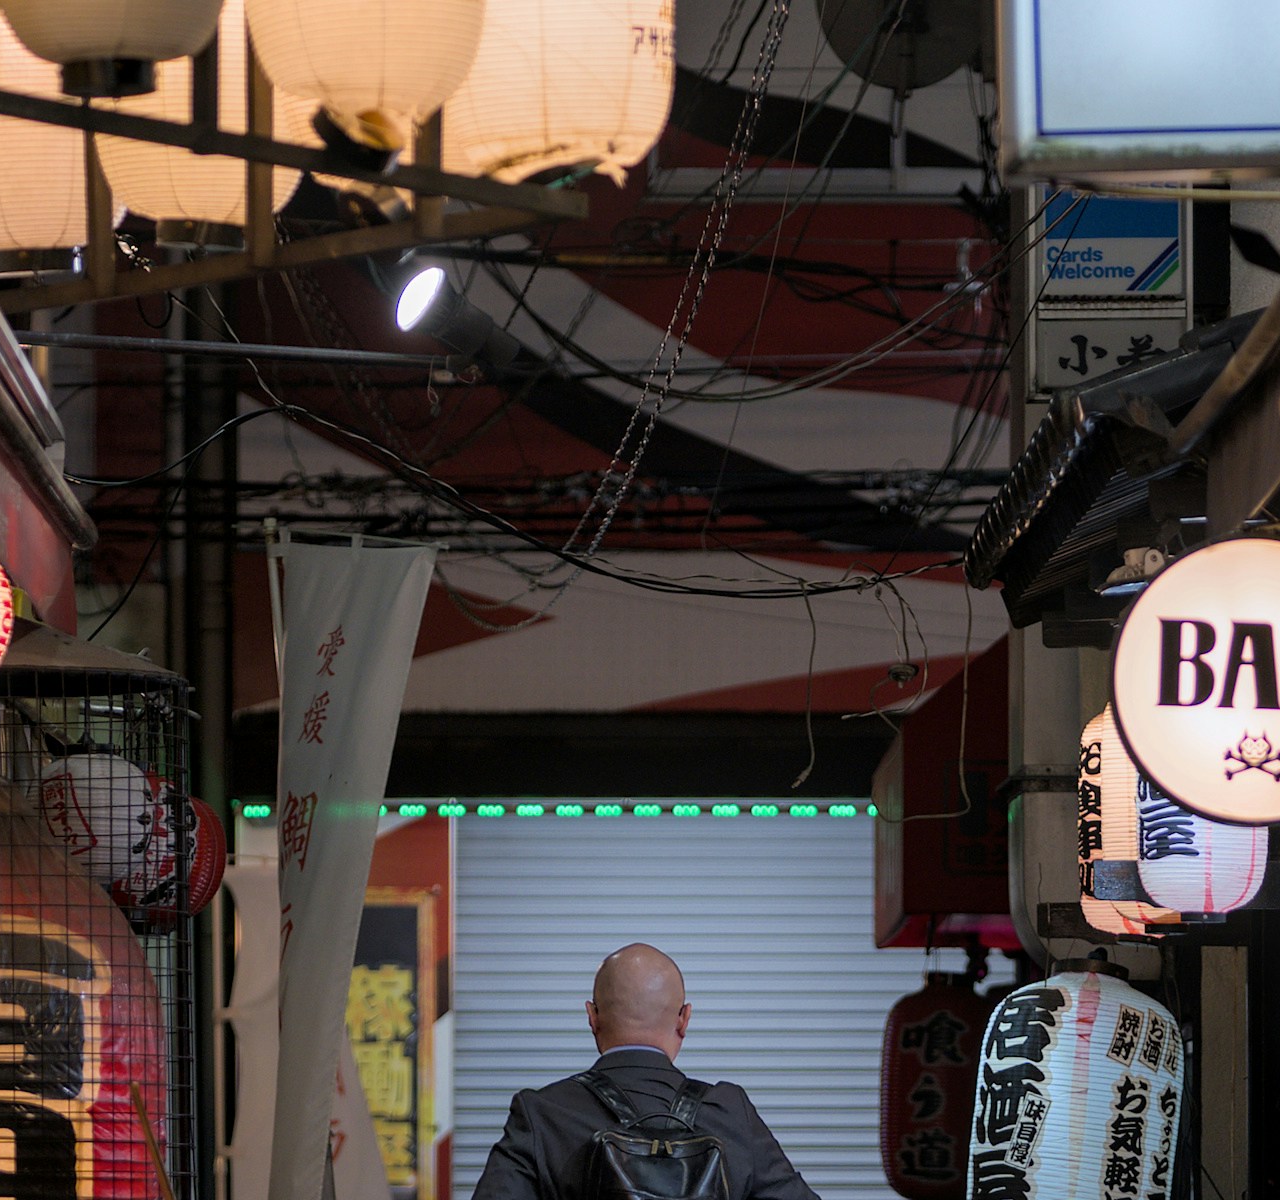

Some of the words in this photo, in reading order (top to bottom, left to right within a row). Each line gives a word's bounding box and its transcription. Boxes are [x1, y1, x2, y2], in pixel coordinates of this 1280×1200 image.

[1046, 246, 1103, 263] Cards
[1047, 263, 1135, 279] Welcome
[1109, 1007, 1141, 1064] 焼酎
[1143, 1016, 1166, 1066] お酒
